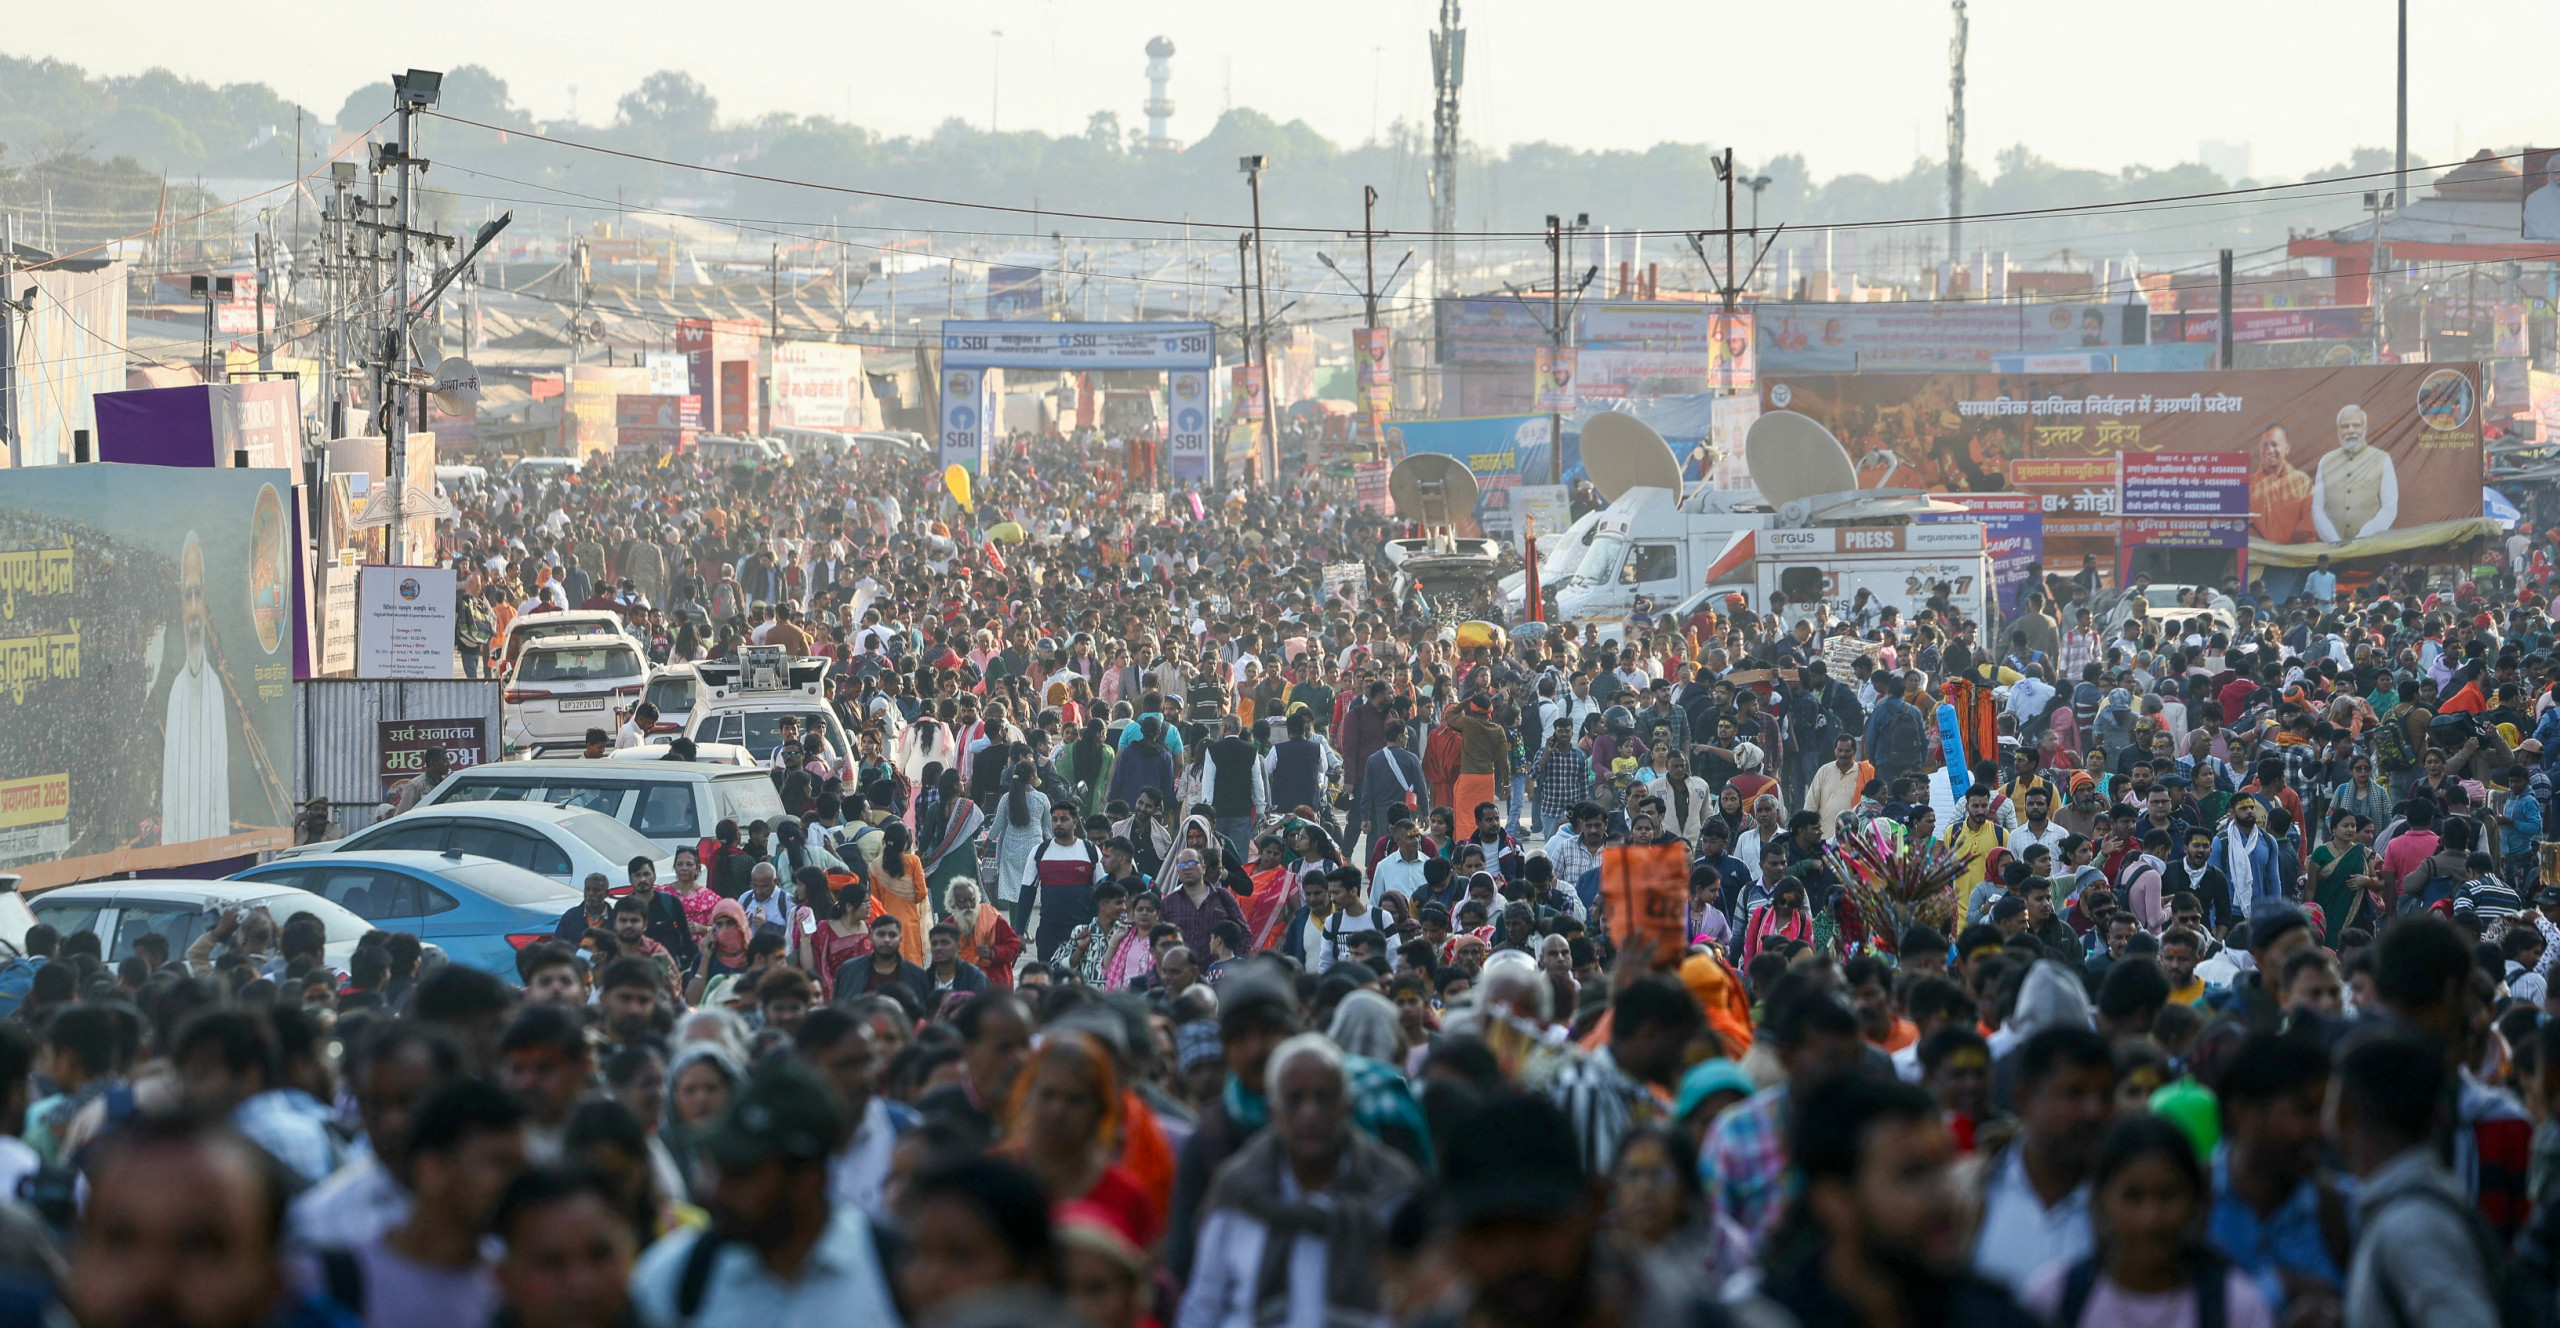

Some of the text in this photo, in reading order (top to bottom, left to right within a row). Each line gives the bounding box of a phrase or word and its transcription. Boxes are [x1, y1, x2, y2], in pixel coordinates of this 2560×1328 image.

[962, 336, 988, 350] SBI
[1073, 335, 1096, 347] SBI
[1181, 337, 1206, 352] SBI
[440, 379, 458, 392] आशा
[1959, 392, 2243, 416] सामाजिक दायित्व निर्वहन में अग्रणी प्रदेश
[946, 432, 974, 448] SBI
[1175, 434, 1202, 450] SBI
[2034, 425, 2104, 453] उत्तर
[2017, 463, 2060, 481] मुख्यमंत्री
[2063, 463, 2104, 481] सामूहिक
[2042, 494, 2067, 512] ख+
[2137, 518, 2167, 532] पुलिस
[2170, 520, 2208, 530] सहायता
[1771, 533, 1815, 544] argus
[1845, 531, 1894, 549] PRESS
[1917, 533, 1979, 542] argusnews.in
[40, 532, 74, 595] फलें
[1905, 576, 1973, 595] 247
[1801, 600, 1849, 612] arus
[389, 724, 476, 742] सर्व सनातन
[43, 780, 67, 808] 2025
